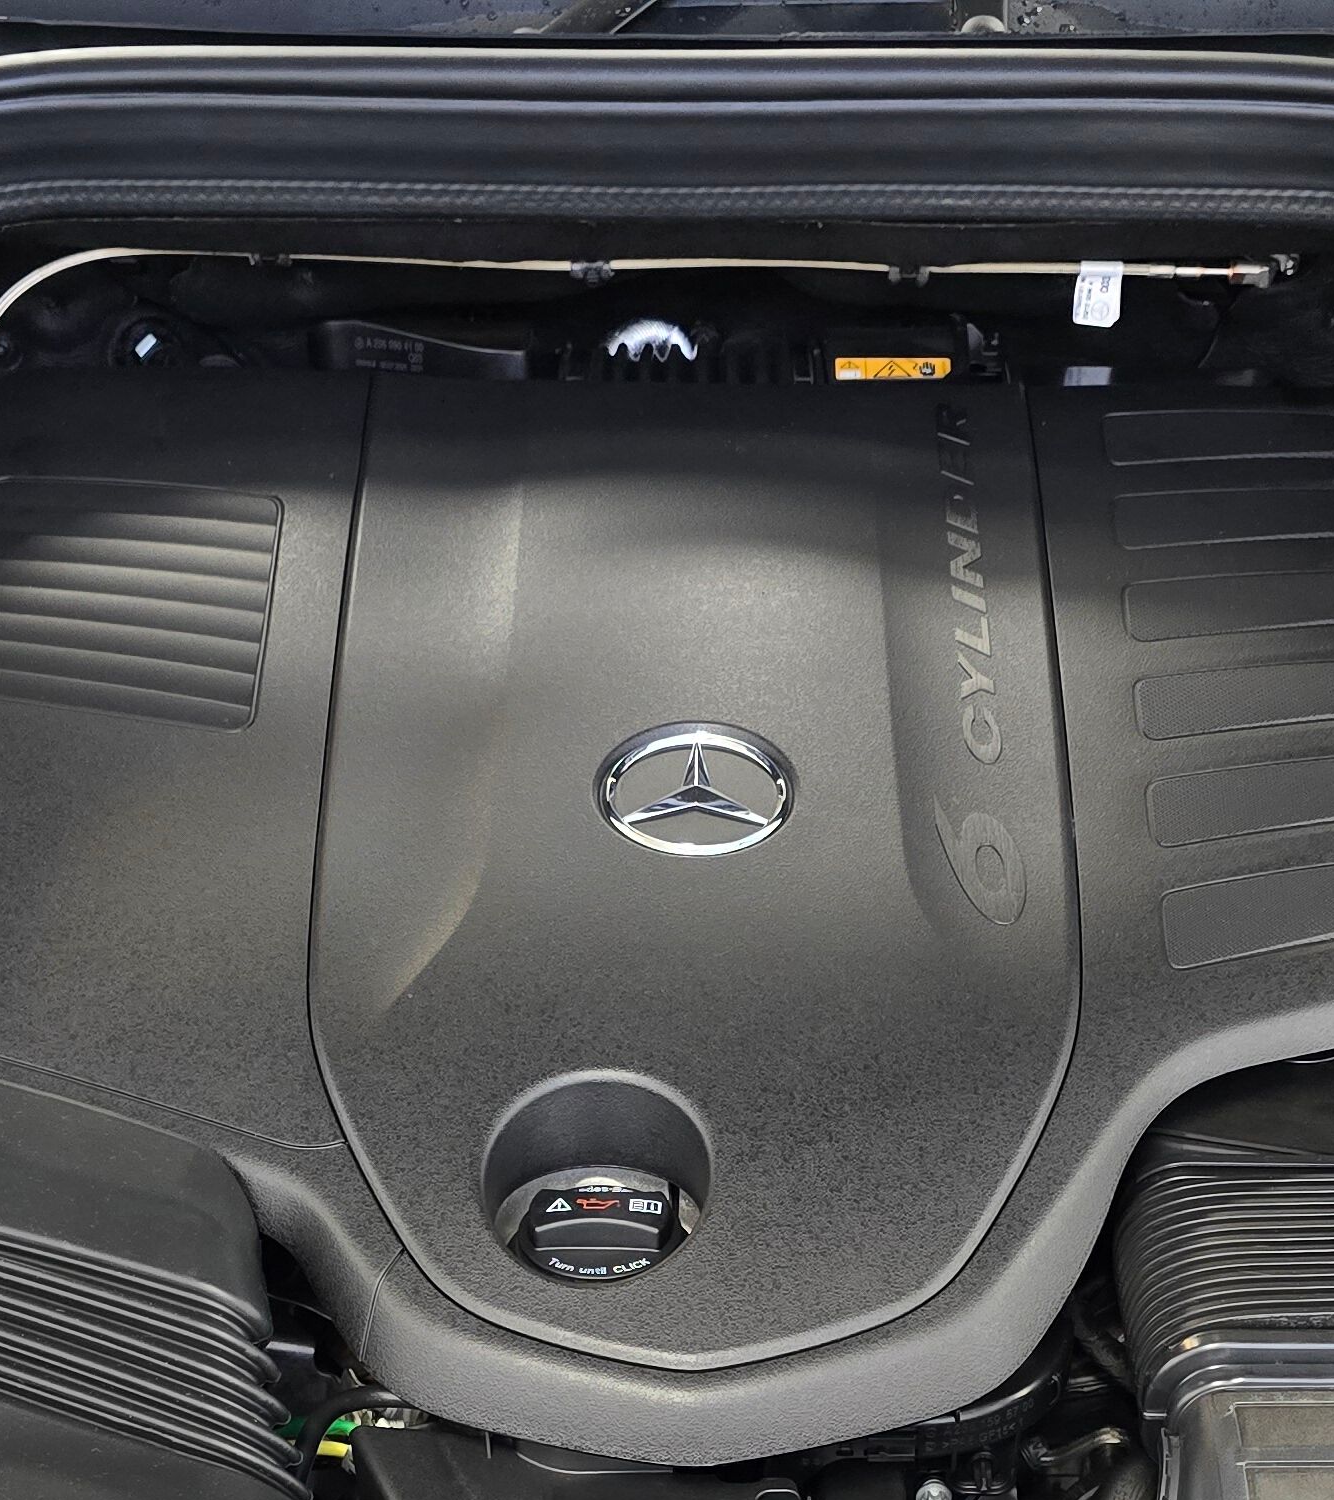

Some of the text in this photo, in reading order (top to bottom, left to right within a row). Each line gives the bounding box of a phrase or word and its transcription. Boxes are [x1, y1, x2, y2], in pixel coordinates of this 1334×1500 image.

[930, 792, 1027, 926] 6
[548, 1257, 651, 1275] Turn until CLICK
